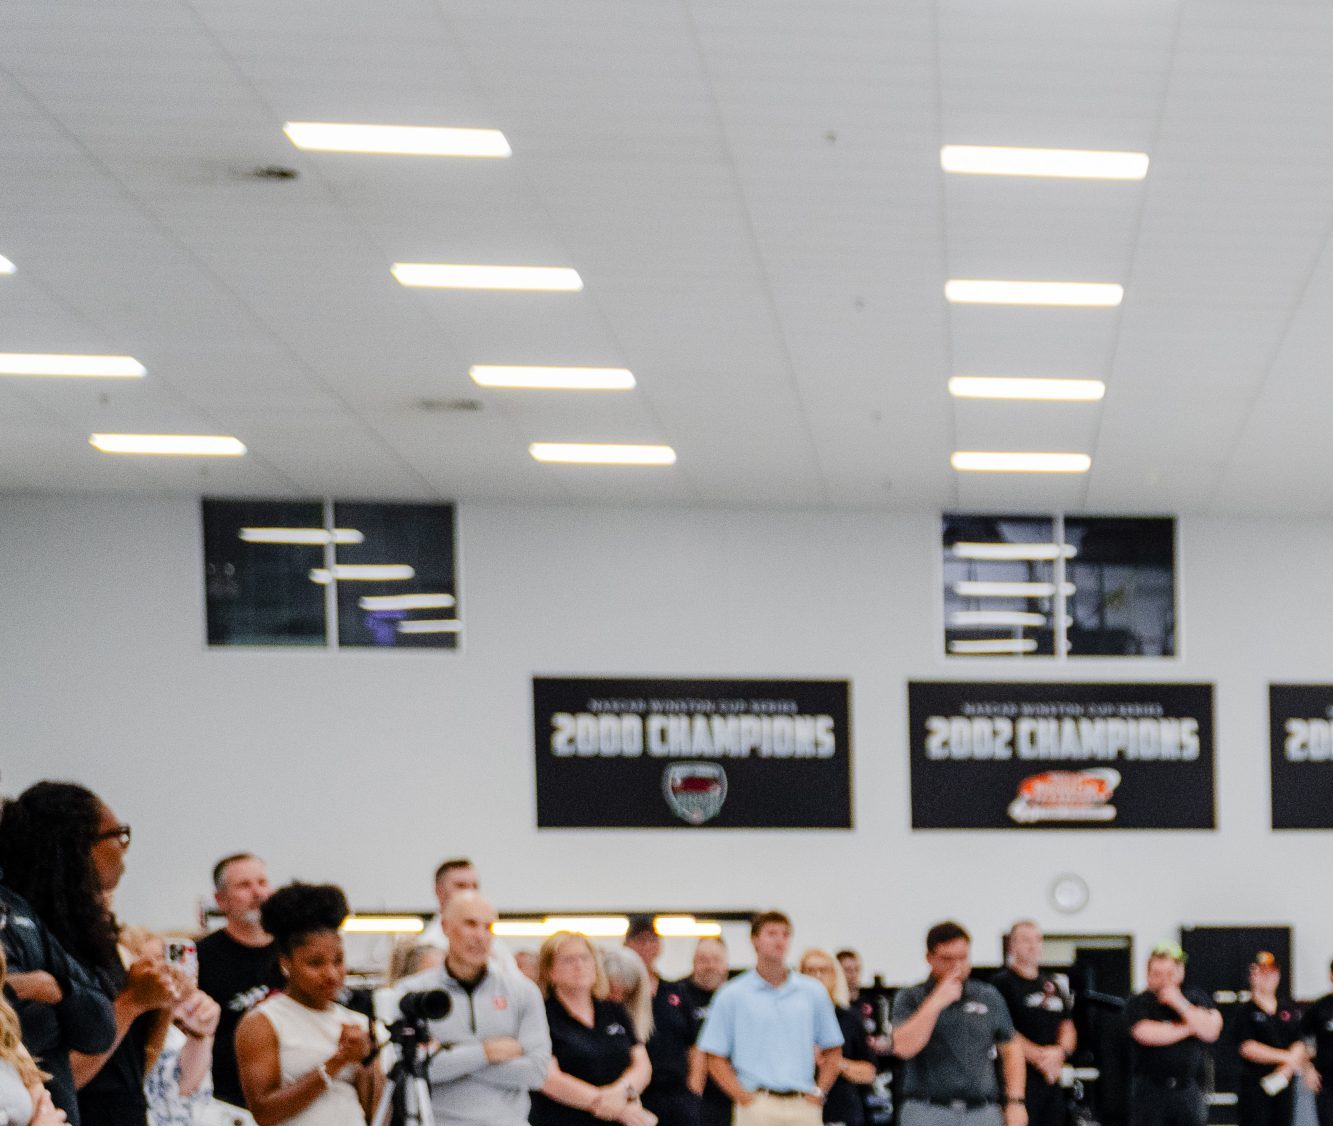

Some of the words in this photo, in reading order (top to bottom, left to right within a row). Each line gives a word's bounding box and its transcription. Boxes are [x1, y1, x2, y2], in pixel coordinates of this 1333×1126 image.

[551, 712, 644, 757] 2000
[647, 713, 835, 758] CHAMPIONS
[925, 715, 1013, 760] 2002
[1016, 716, 1200, 761] CHAMPIONS
